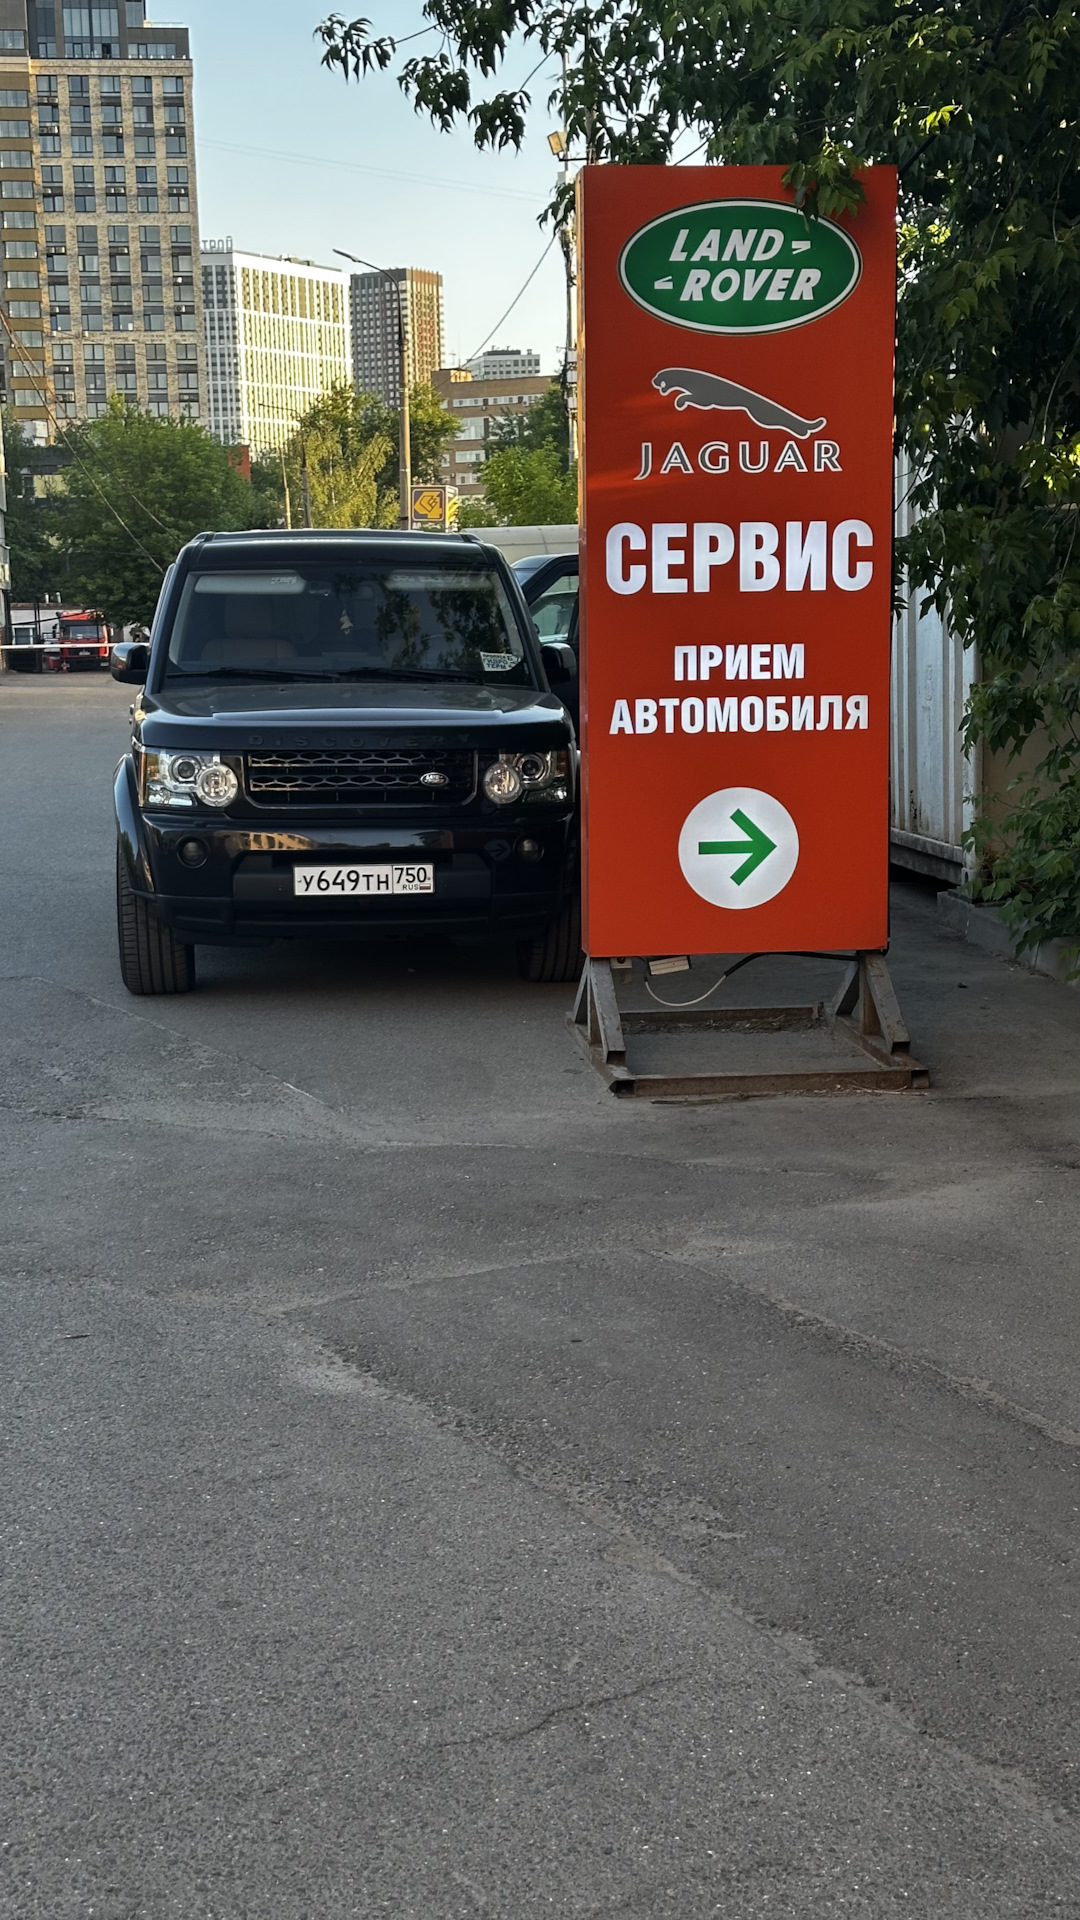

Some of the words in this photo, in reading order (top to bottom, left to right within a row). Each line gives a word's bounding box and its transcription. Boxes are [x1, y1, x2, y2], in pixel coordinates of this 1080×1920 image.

[669, 229, 784, 261] LAND
[680, 268, 821, 301] ROVER
[633, 440, 842, 480] JAGUAR
[605, 519, 873, 595] СЕРВИС
[674, 643, 805, 681] ПРИЕМ
[609, 694, 869, 734] АВТОМОБИЛЯ
[248, 734, 470, 748] DISCOVERY
[303, 870, 389, 891] У649ТН
[394, 867, 427, 883] 750
